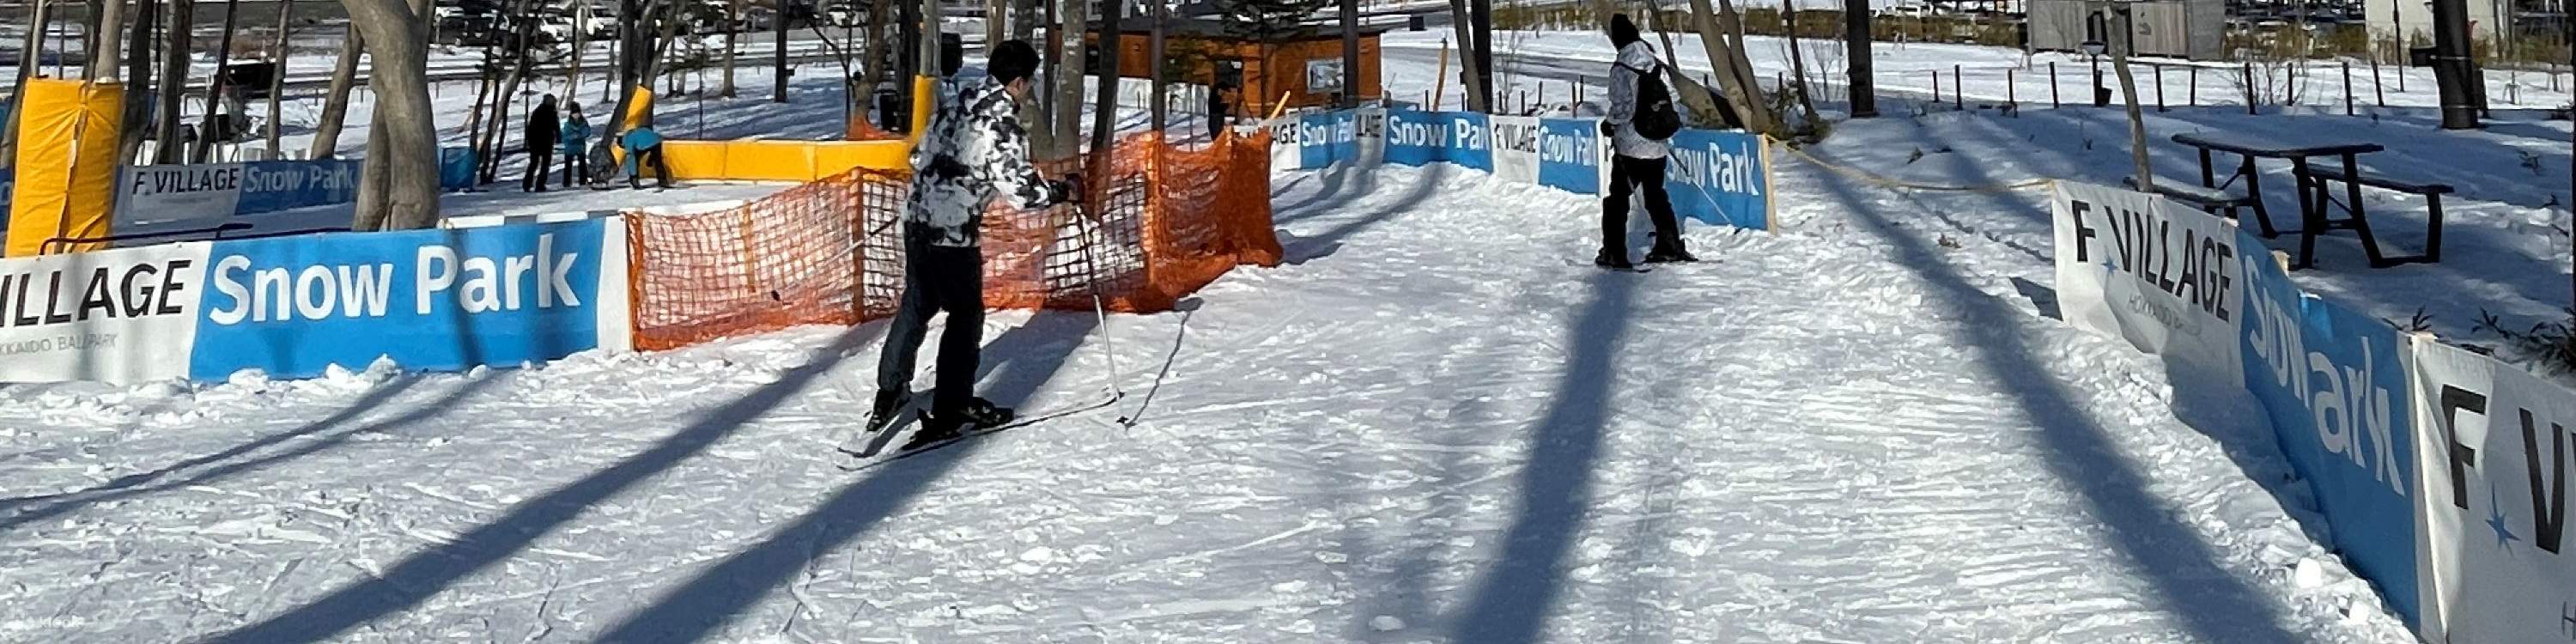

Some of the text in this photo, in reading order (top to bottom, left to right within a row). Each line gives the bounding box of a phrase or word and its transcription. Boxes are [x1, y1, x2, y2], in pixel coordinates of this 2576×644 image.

[1388, 115, 1448, 147] Snow
[1540, 125, 1573, 164] Snow
[155, 168, 239, 193] VILLAGE
[245, 162, 358, 193] Snow Park
[1709, 141, 1759, 195] Park
[210, 234, 580, 325] Snow Park
[2072, 200, 2233, 323] F VILLAGE
[2307, 336, 2404, 496] ark
[2441, 384, 2576, 555] F V
